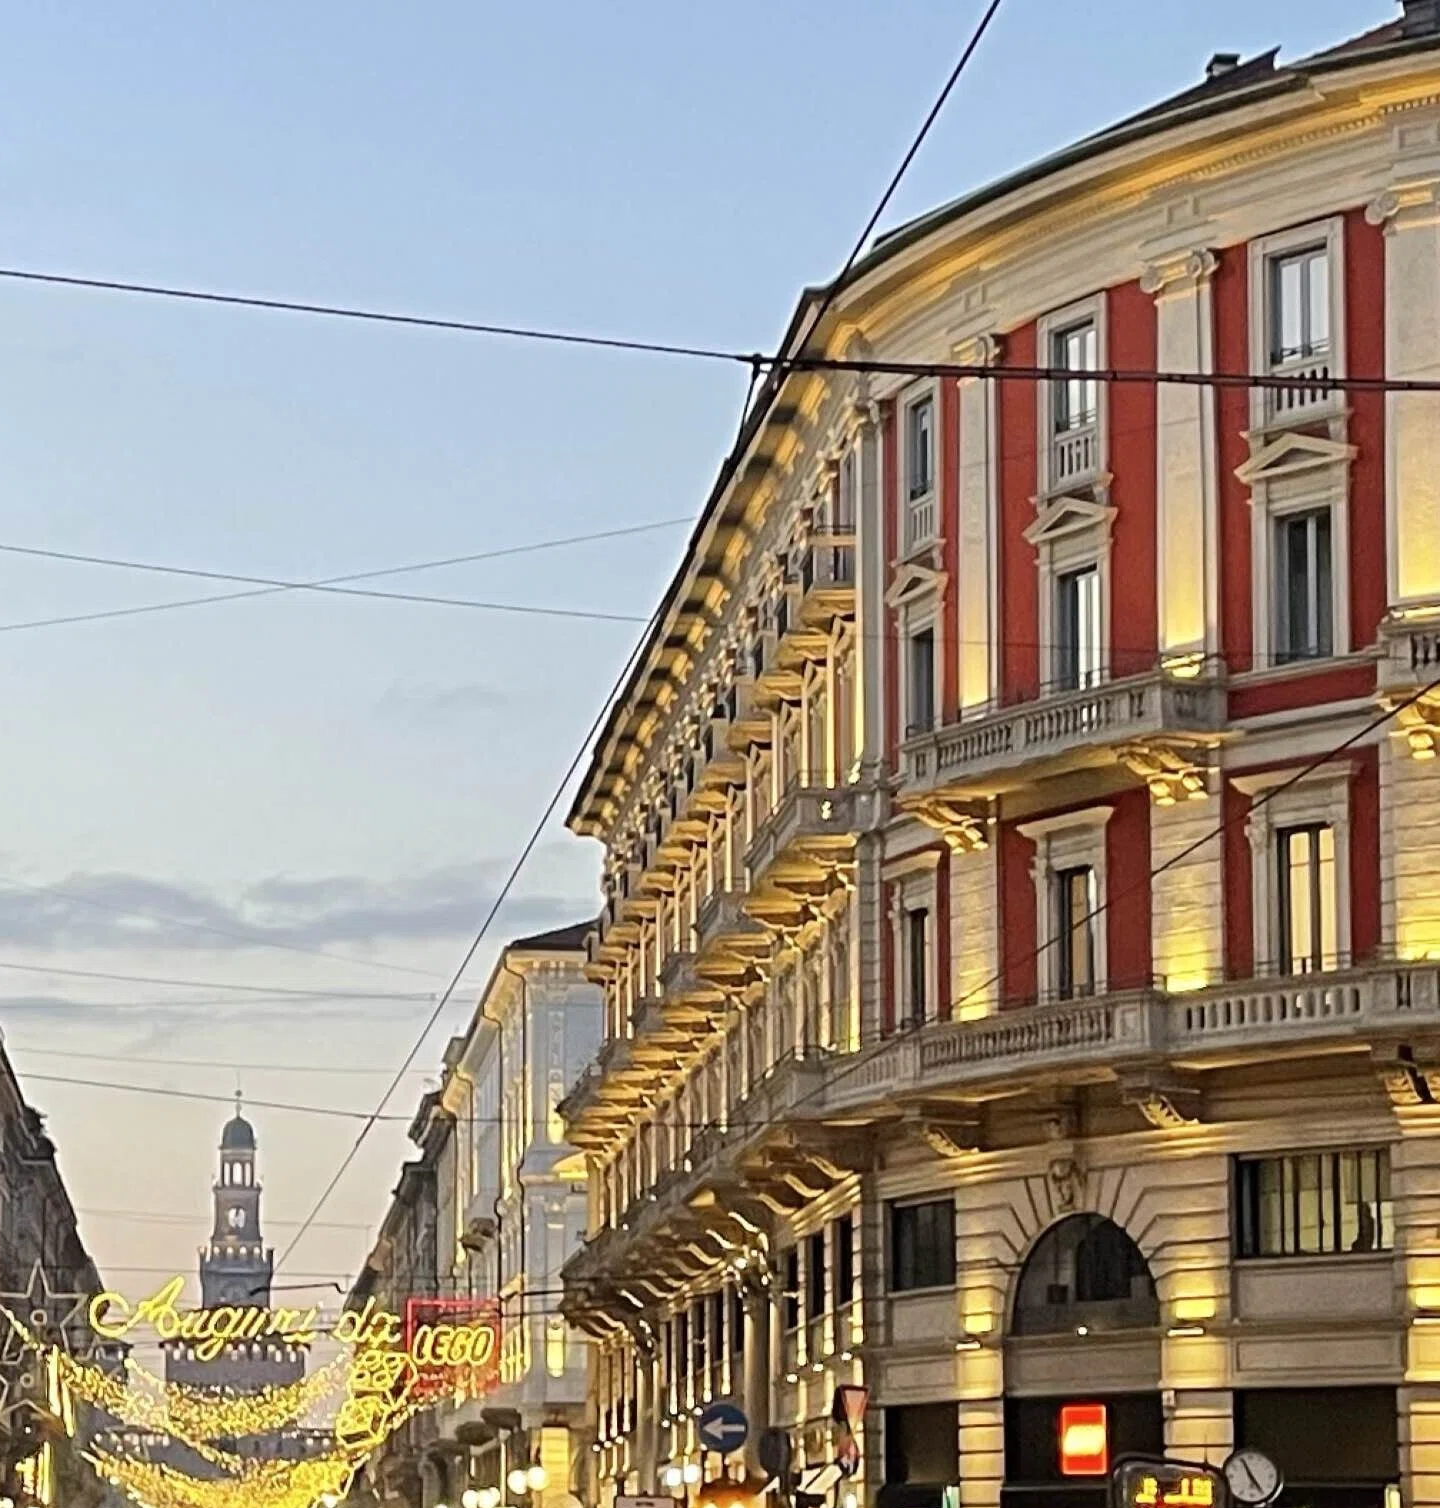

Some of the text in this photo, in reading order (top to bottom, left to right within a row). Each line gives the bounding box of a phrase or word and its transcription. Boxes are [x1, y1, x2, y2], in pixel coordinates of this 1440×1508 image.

[89, 1276, 495, 1366] Auguri da LEGO
